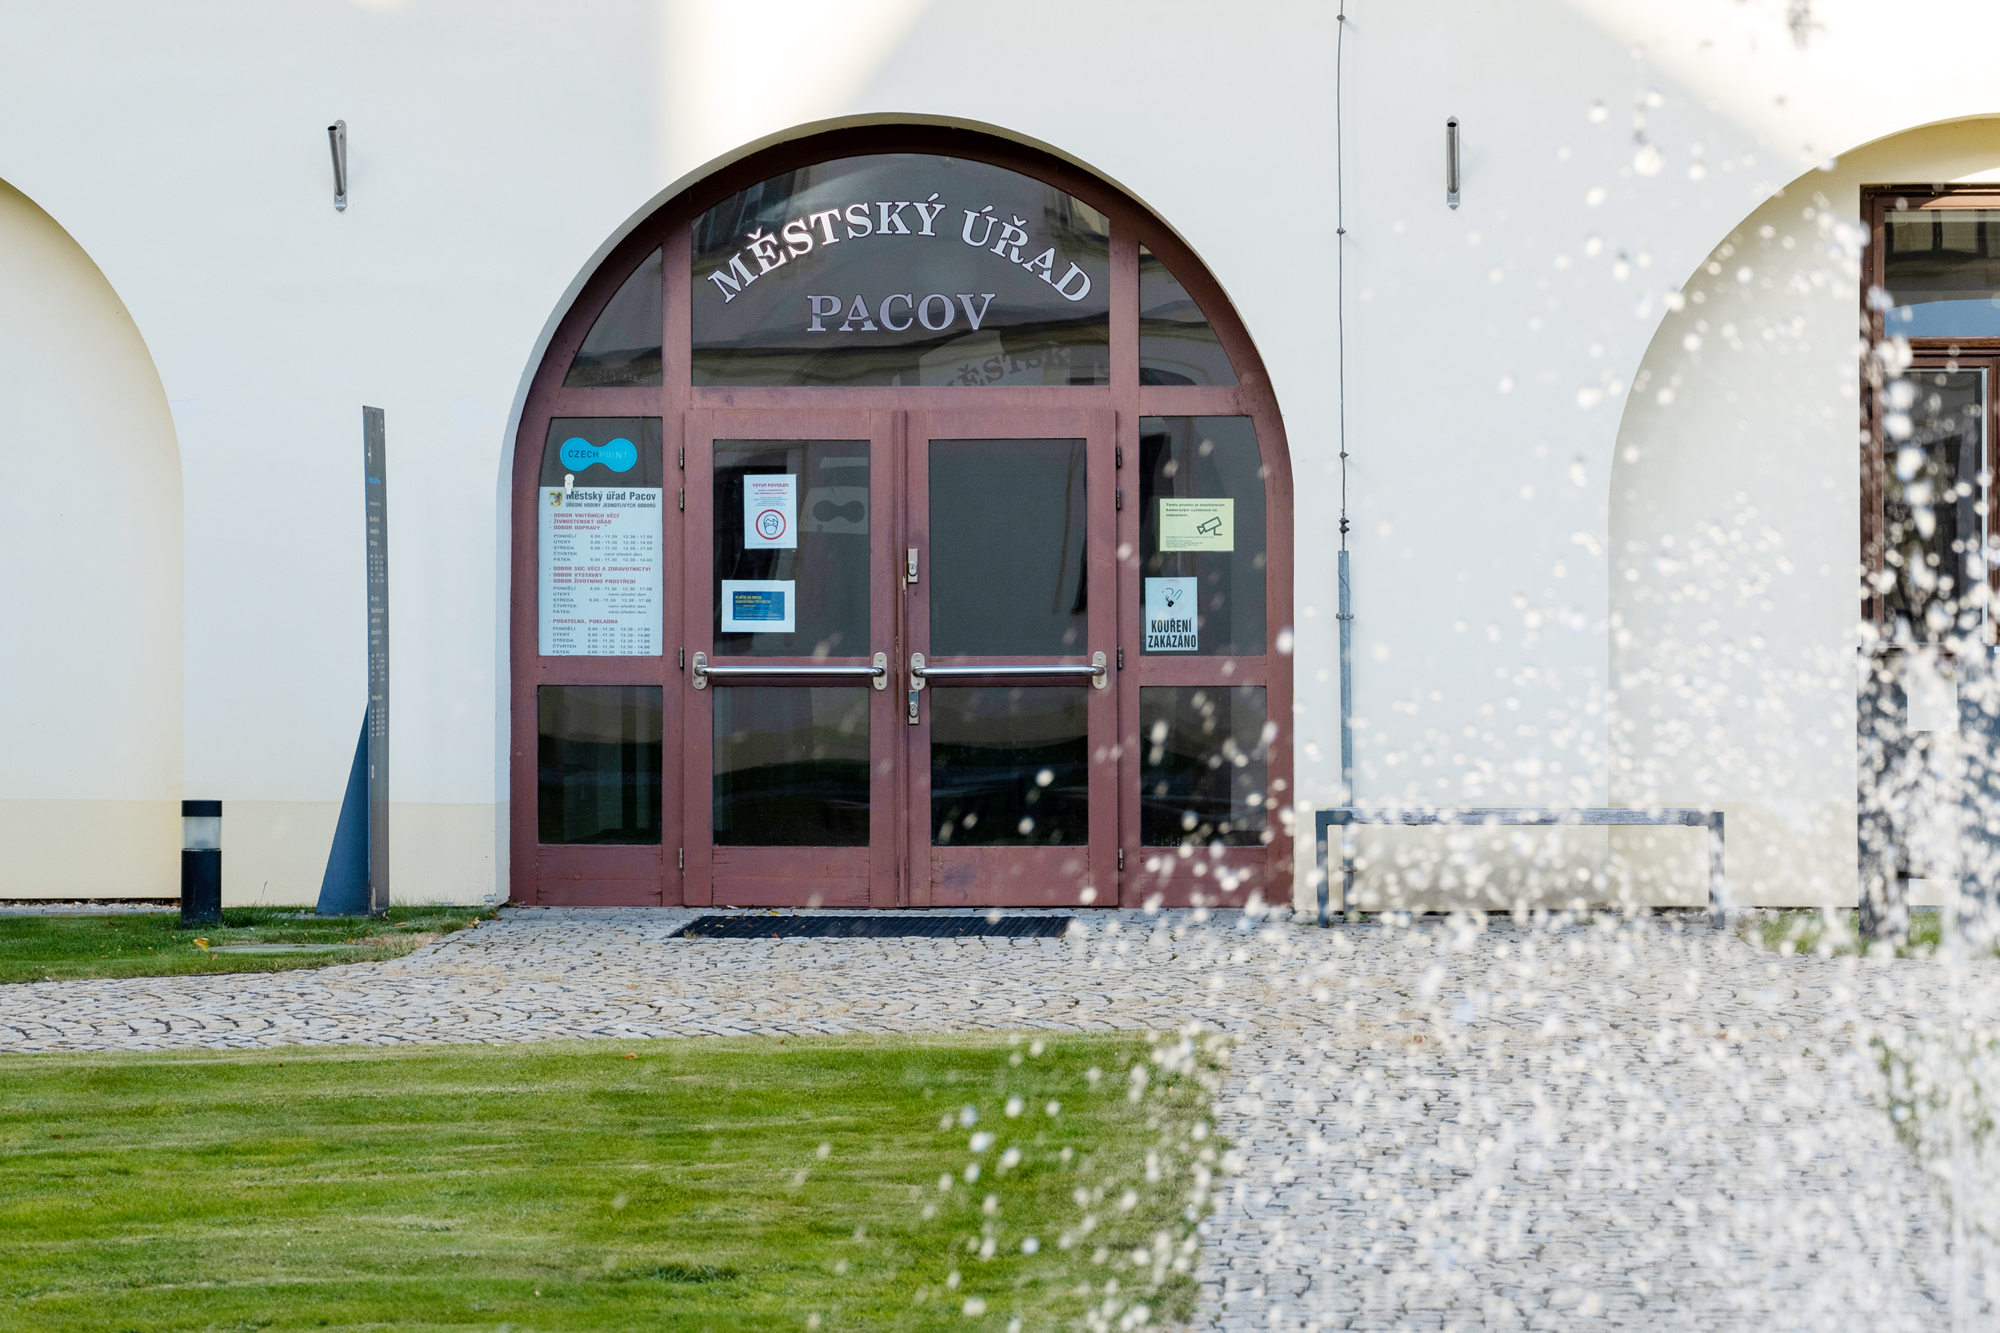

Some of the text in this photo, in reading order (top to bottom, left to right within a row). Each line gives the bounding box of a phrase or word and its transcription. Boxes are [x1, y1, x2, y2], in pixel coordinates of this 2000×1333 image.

[707, 192, 1092, 303] MĚSTSKÝ ÚŘAD
[806, 293, 996, 332] PACOV
[566, 491, 656, 502] Městský úřad Pacov
[1152, 618, 1192, 632] KOUŘENÍ
[1148, 633, 1196, 648] ZAKÁZÁNO
